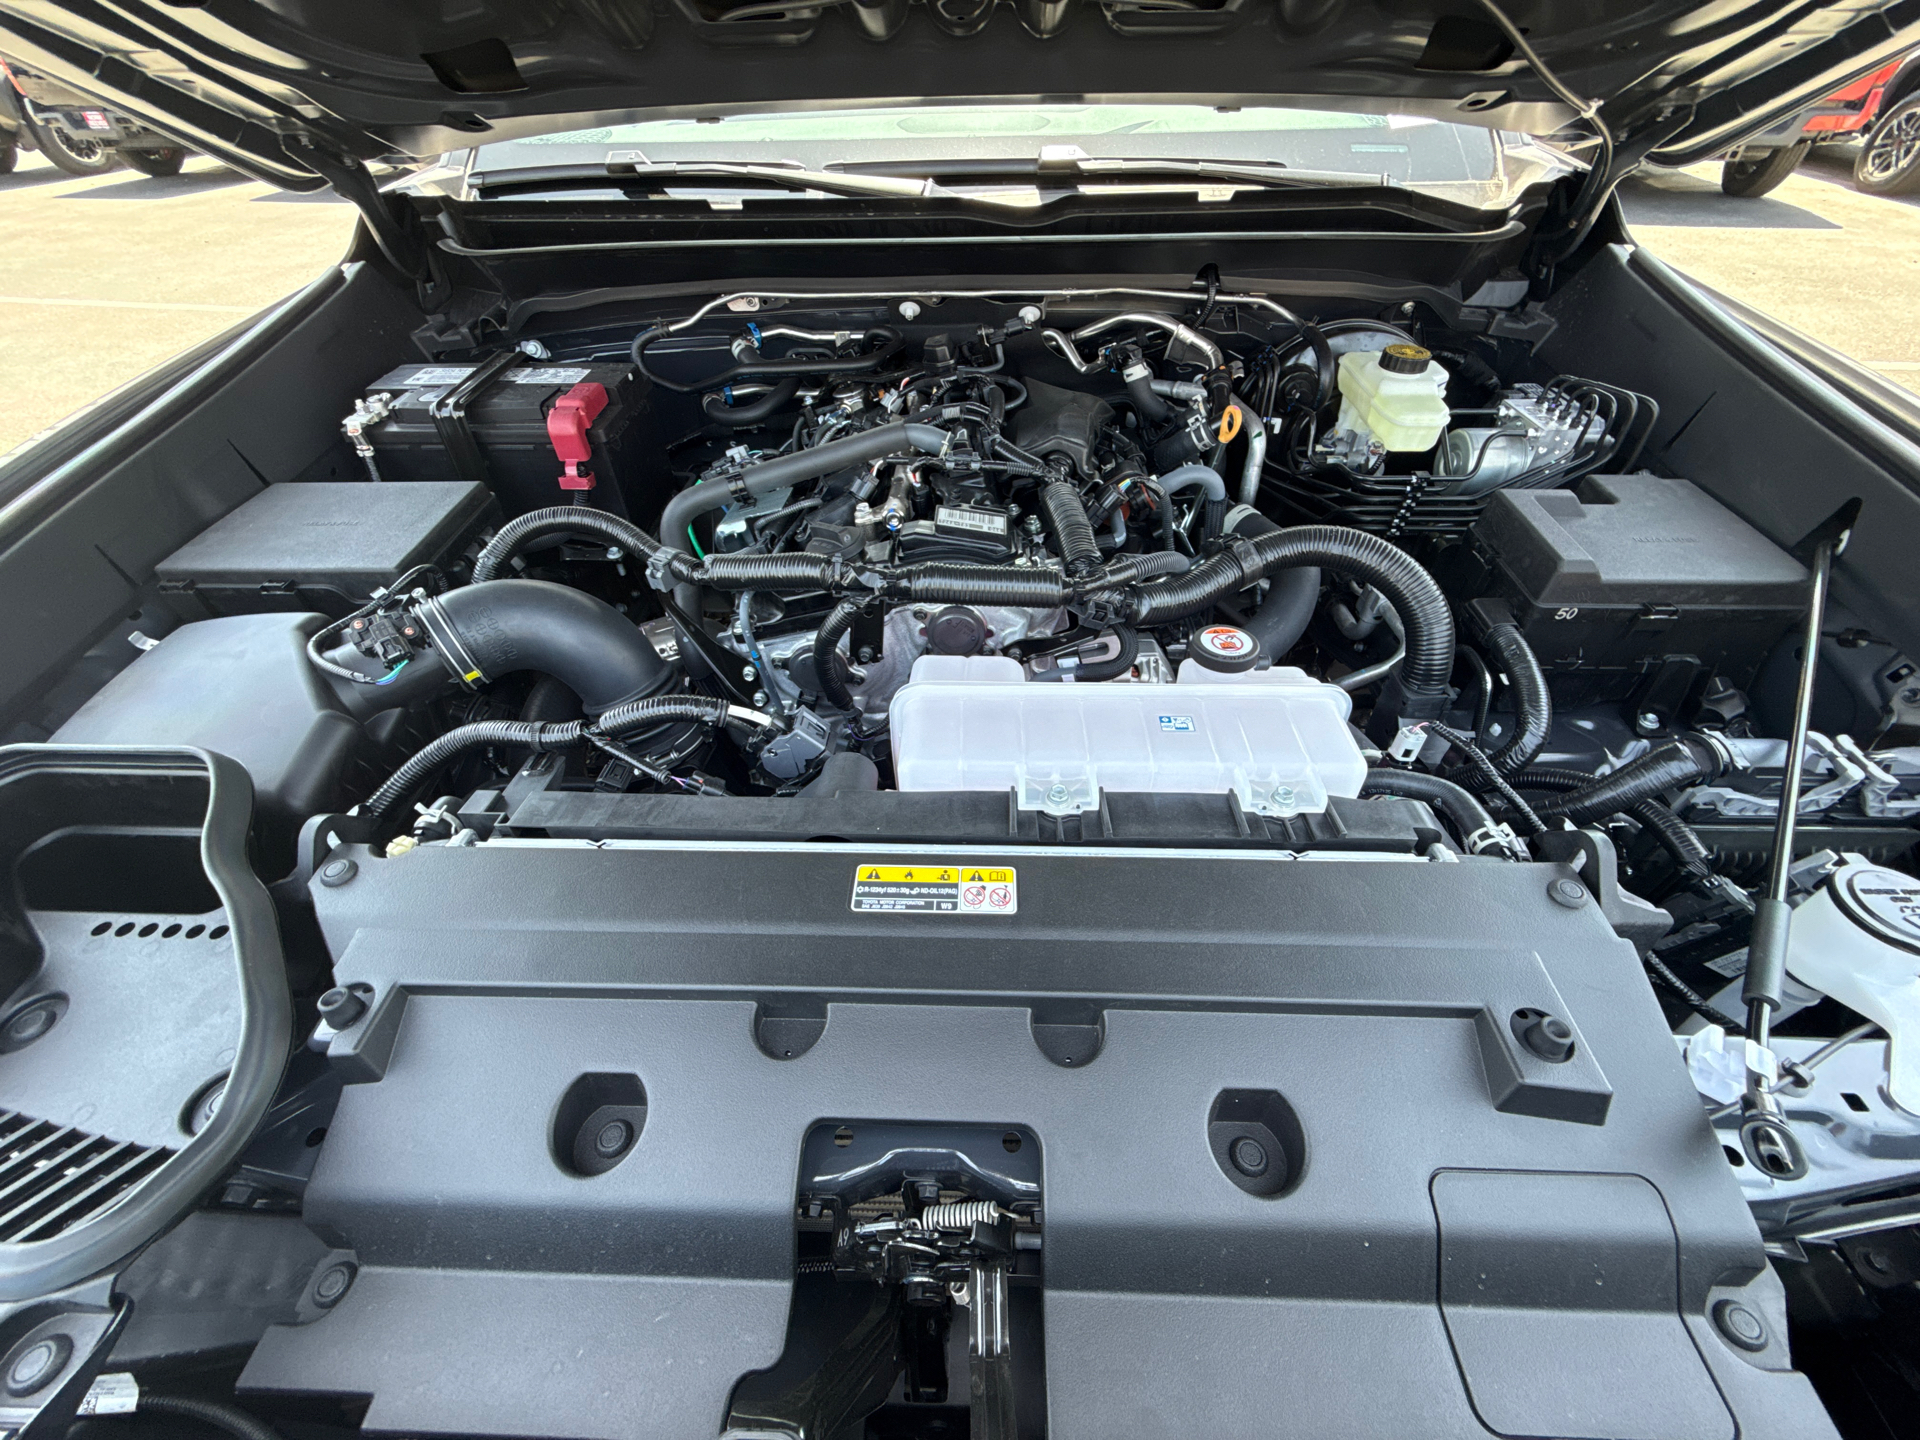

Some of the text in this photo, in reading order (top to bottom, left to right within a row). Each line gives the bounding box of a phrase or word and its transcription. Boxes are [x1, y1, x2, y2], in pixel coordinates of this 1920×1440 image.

[1554, 607, 1578, 620] 50
[864, 886, 886, 894] R-1234yf
[941, 902, 952, 910] W9
[837, 1227, 850, 1247] A9
